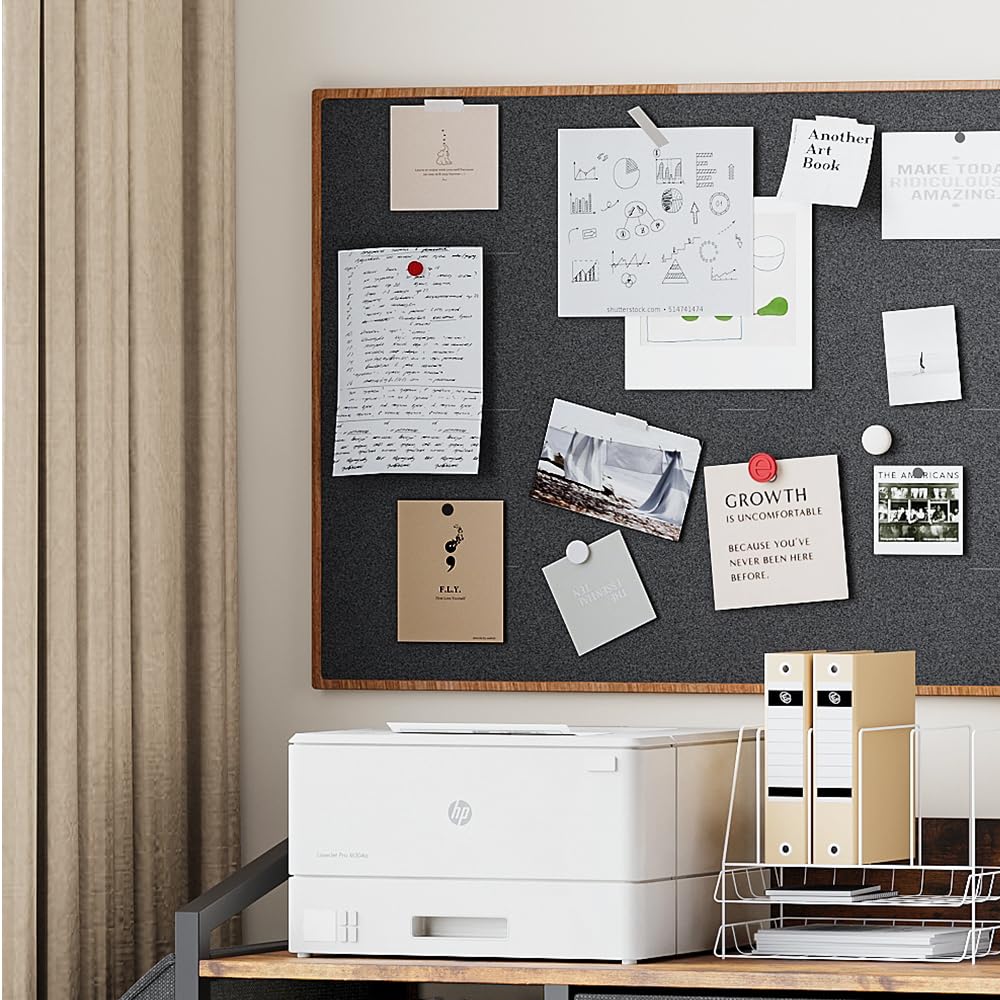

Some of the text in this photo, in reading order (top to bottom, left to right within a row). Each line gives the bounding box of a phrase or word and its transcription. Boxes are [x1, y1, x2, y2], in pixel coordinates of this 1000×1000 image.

[808, 129, 872, 144] Another
[806, 143, 832, 155] Art
[802, 157, 840, 171] Book
[897, 164, 949, 175] MAKE
[911, 189, 1000, 201] AMAZING.
[901, 471, 960, 479] AMRICANS
[725, 487, 807, 508] GROWTH
[726, 506, 823, 523] IS UNCOMFORTABLE
[728, 537, 811, 553] BECAUSE YOU'VE
[729, 552, 814, 567] NEVER BEEN HERE
[731, 571, 770, 582] BEFORE.
[450, 800, 471, 825] hp
